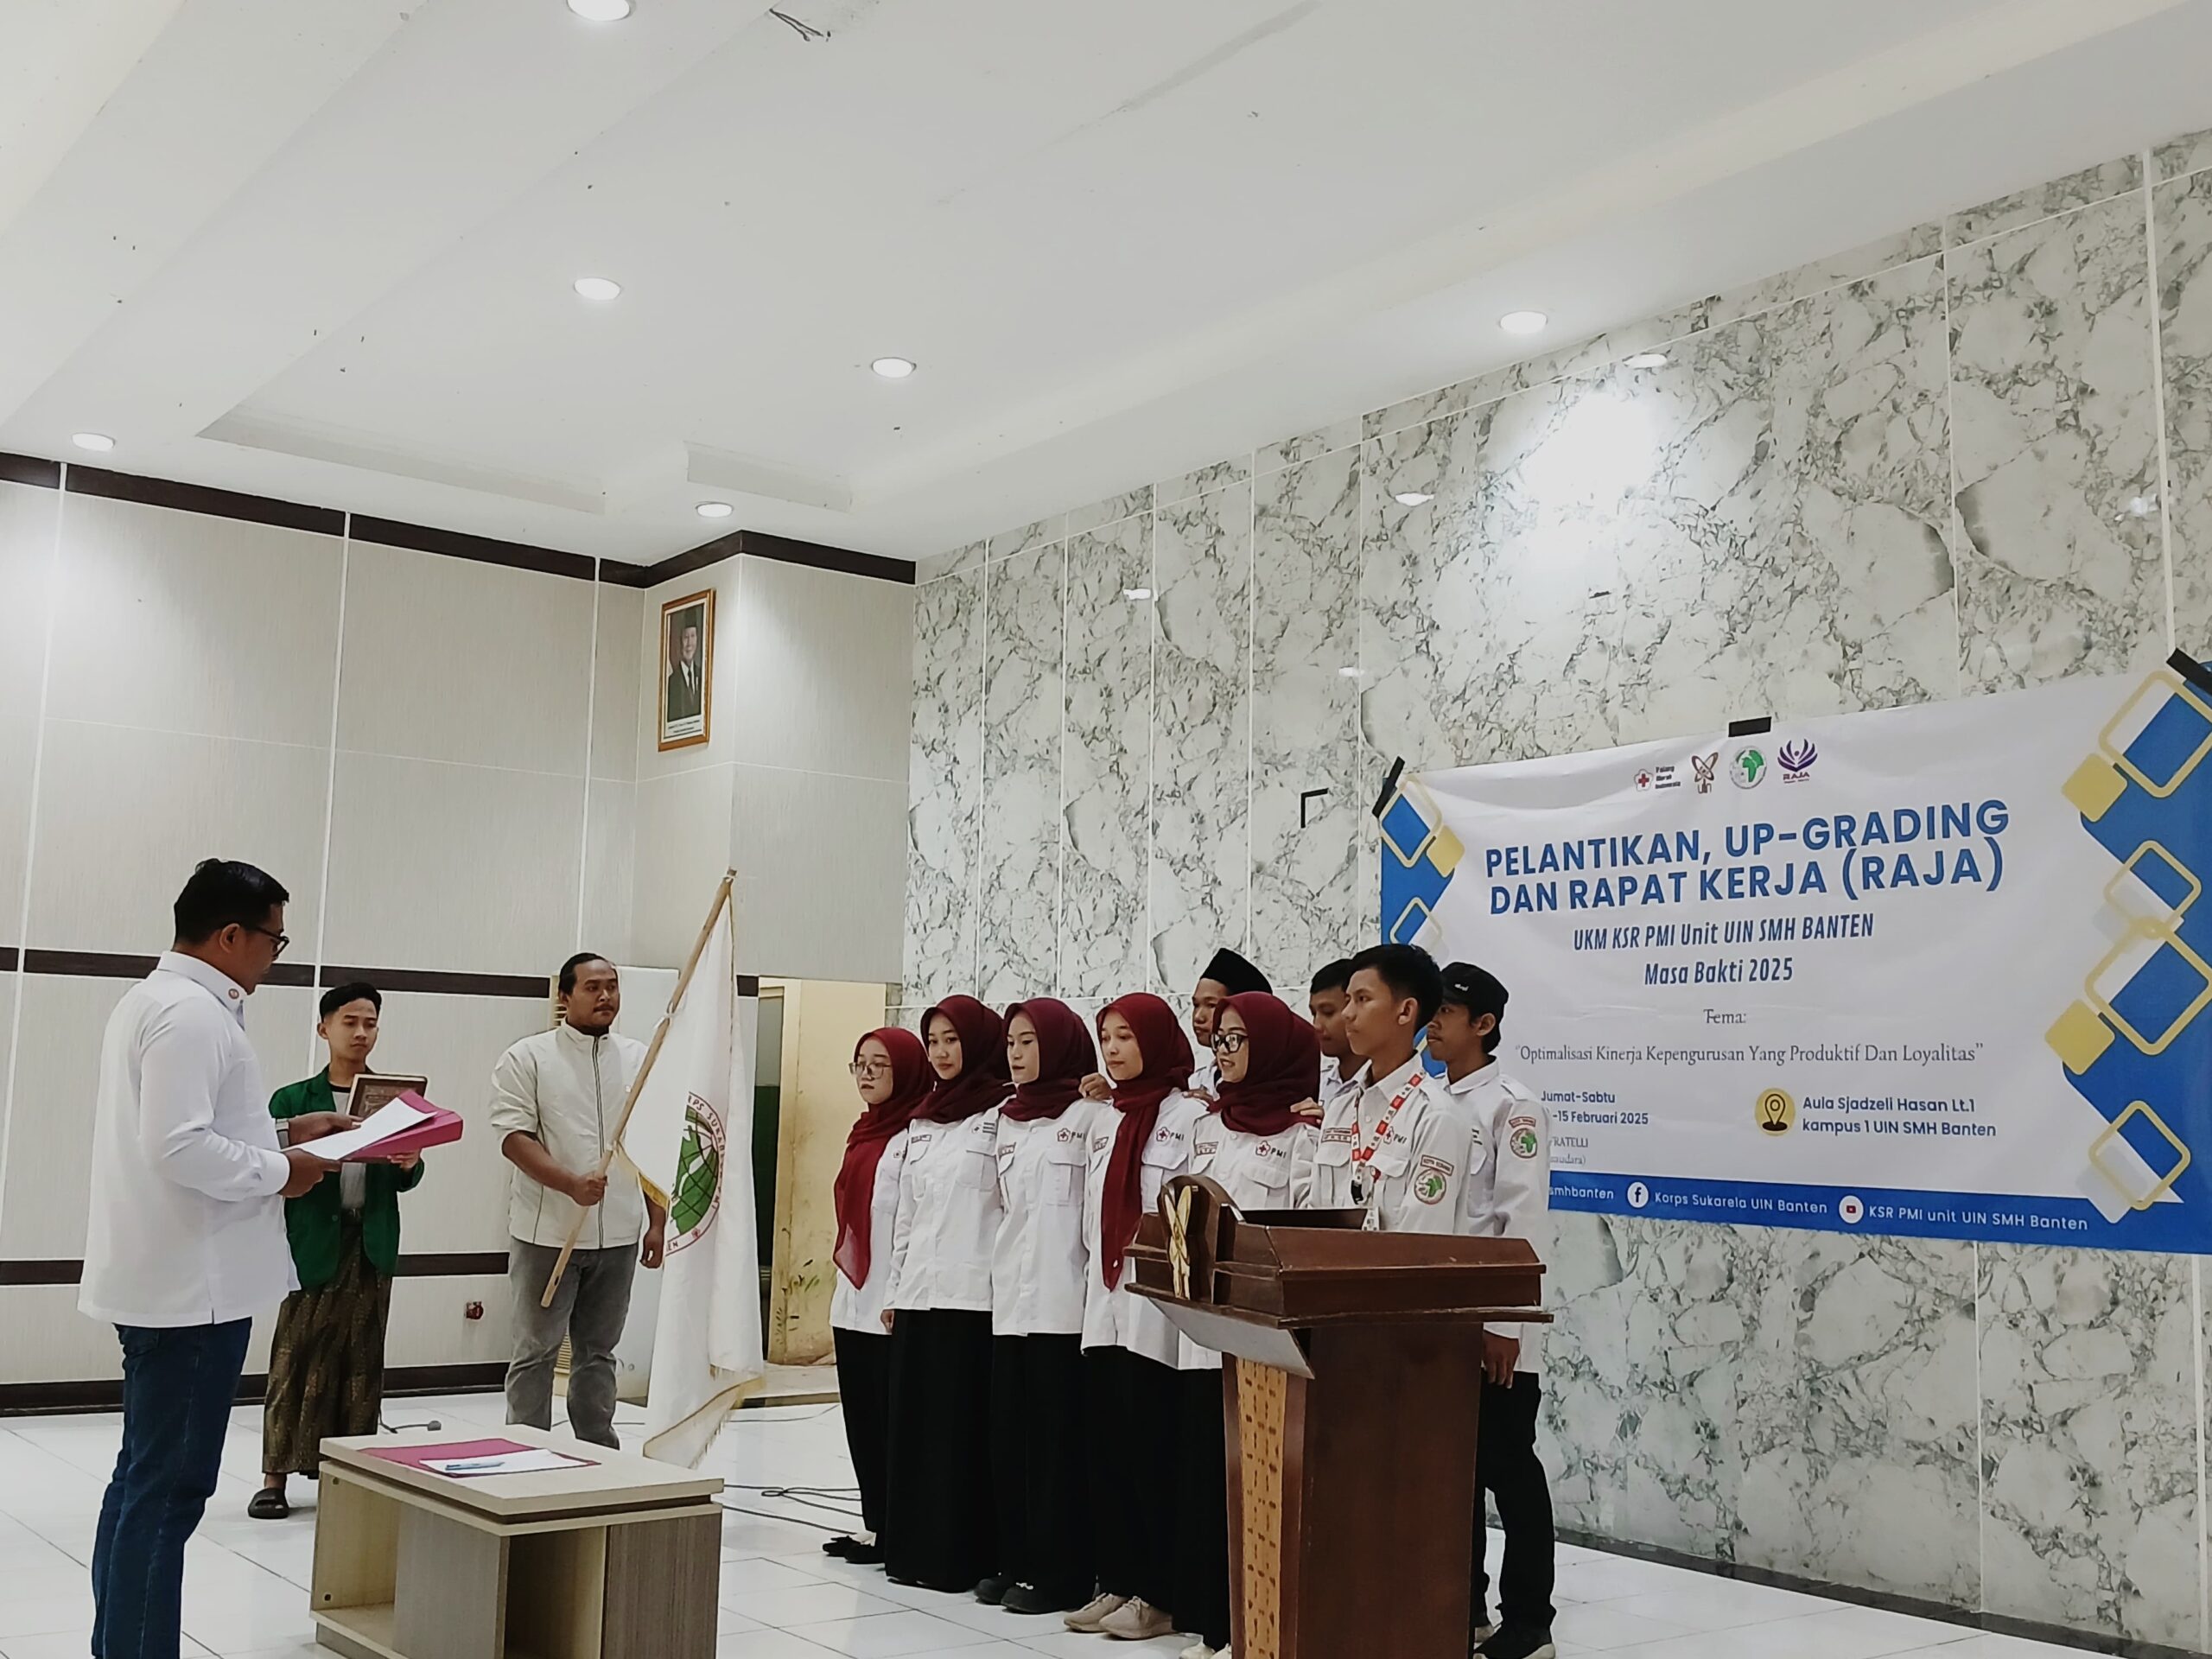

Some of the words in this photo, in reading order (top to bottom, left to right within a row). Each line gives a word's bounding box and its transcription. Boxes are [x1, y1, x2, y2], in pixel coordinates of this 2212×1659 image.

[1486, 830, 1711, 878] PELANTIKAN,
[1726, 800, 2009, 857] UP-GRADING
[1491, 881, 1558, 914] DAN
[1569, 871, 1688, 909] RAPAT
[1700, 861, 1827, 900] KERJA
[1842, 836, 2003, 900] (RAJA)
[1573, 928, 1607, 950] UKM
[1612, 926, 1640, 949] KSR
[1644, 924, 1675, 948] PMI
[1681, 921, 1719, 945] Unit
[1724, 919, 1754, 944] UIN
[1758, 918, 1796, 942] SMH
[1802, 912, 1874, 940] BANTEN
[1644, 963, 1688, 985] Masa
[1694, 958, 1743, 983] Bakti
[1748, 957, 1794, 982] 2025
[1703, 1008, 1747, 1025] Tema:
[1596, 1045, 1643, 1065] Kinerja
[1646, 1046, 1745, 1066] Kepengurusan
[1748, 1045, 1787, 1066] Yang
[1789, 1043, 1860, 1062] Produktif
[1864, 1044, 1898, 1062] Dan
[1541, 1090, 1616, 1103] Jumat-Sabtu
[1802, 1096, 1834, 1110] Aula
[1837, 1096, 1894, 1114] Sjadzeli
[1897, 1098, 1948, 1113] Hasan
[1952, 1098, 1975, 1113] Lt.1
[1570, 1110, 1618, 1124] Februari
[1620, 1112, 1649, 1125] 2025
[1802, 1118, 1861, 1136] kampus
[1864, 1120, 1871, 1133] 1
[1873, 1121, 1899, 1134] UIN
[1903, 1122, 1938, 1135] SMH
[1941, 1122, 1997, 1137] Banten
[1655, 1192, 1688, 1206] Korps
[1692, 1193, 1747, 1210] Sukarela
[1751, 1198, 1773, 1211] UIN
[1777, 1199, 1828, 1214] Banten
[1869, 1205, 1894, 1219] KSR
[1898, 1207, 1923, 1221] PMI
[1927, 1209, 1957, 1223] unit
[1961, 1211, 1987, 1225] UIN
[1992, 1213, 2024, 1227] SMH
[2030, 1215, 2088, 1231] Banten
